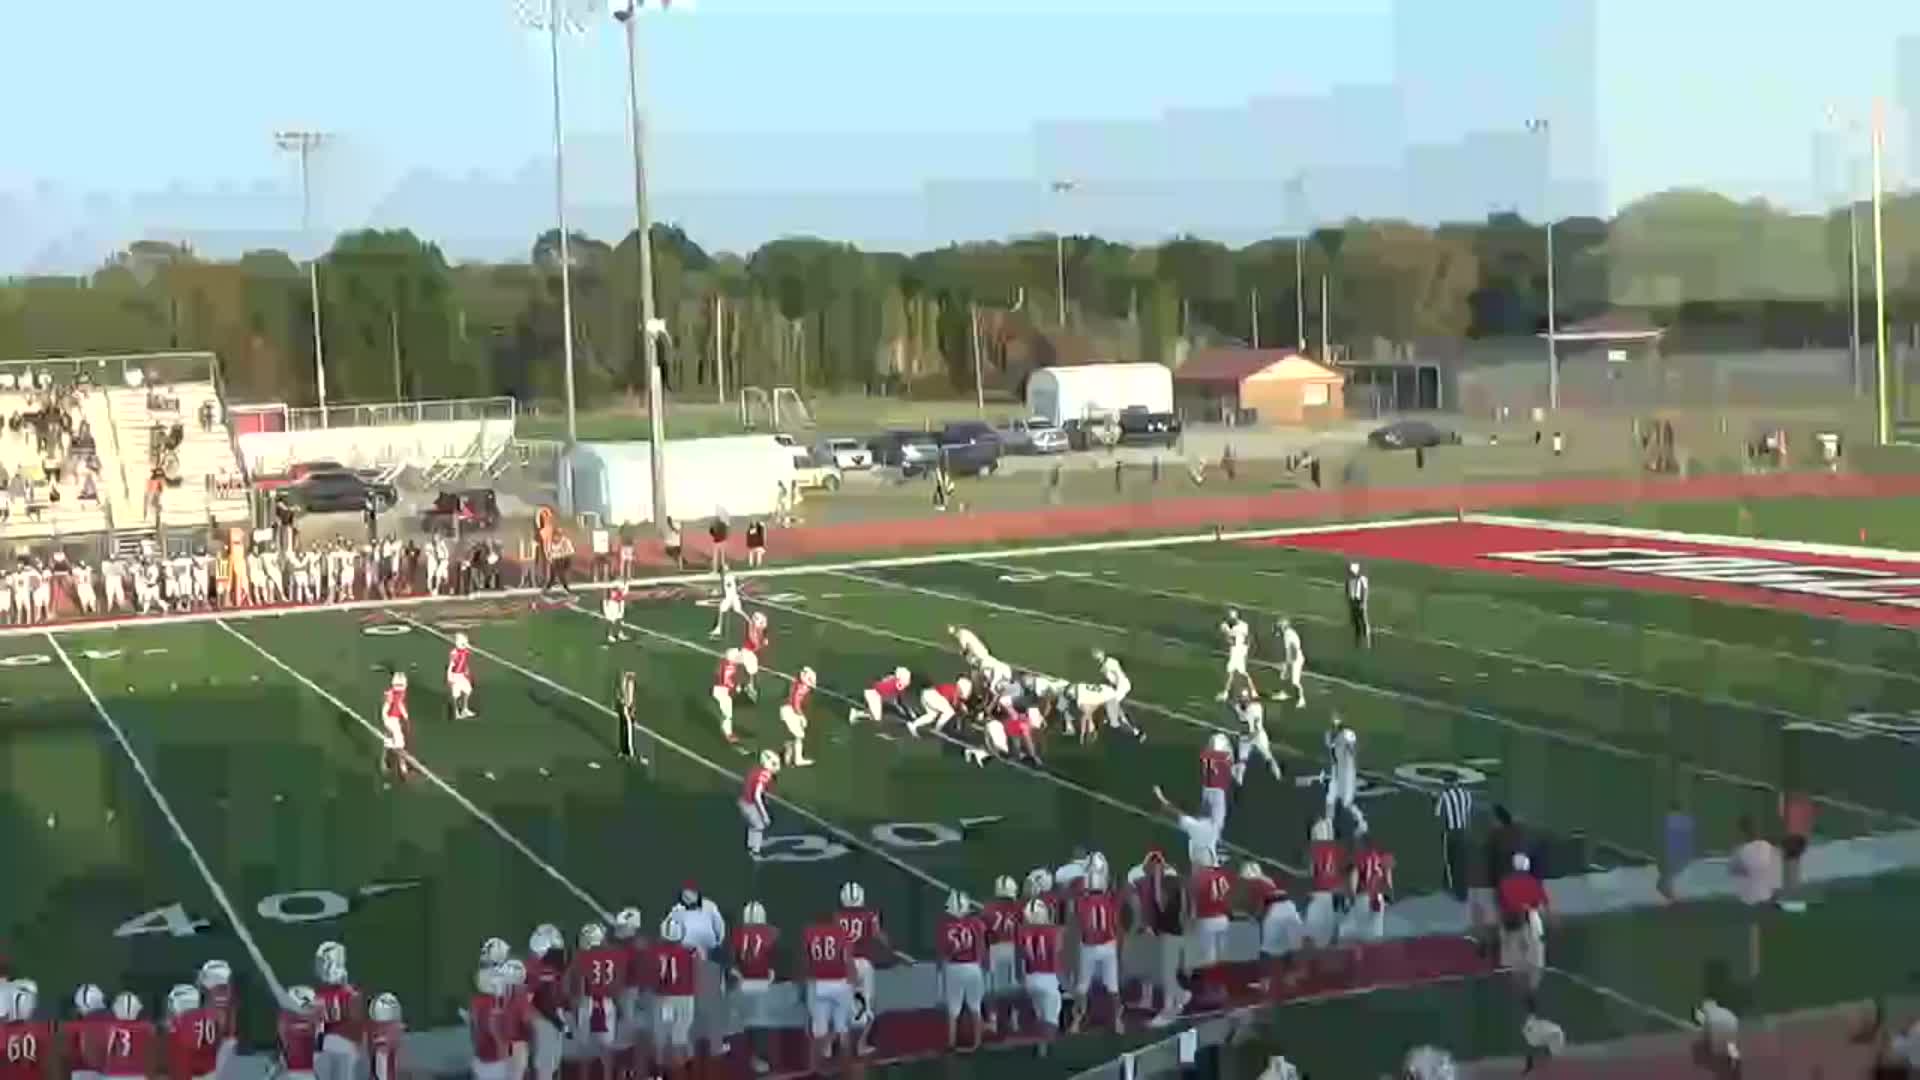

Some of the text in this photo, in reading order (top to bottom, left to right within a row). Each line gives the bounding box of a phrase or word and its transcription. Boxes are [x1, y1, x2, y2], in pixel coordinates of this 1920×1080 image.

[757, 822, 962, 861] 30
[113, 889, 350, 937] 40
[7, 1032, 37, 1063] 60
